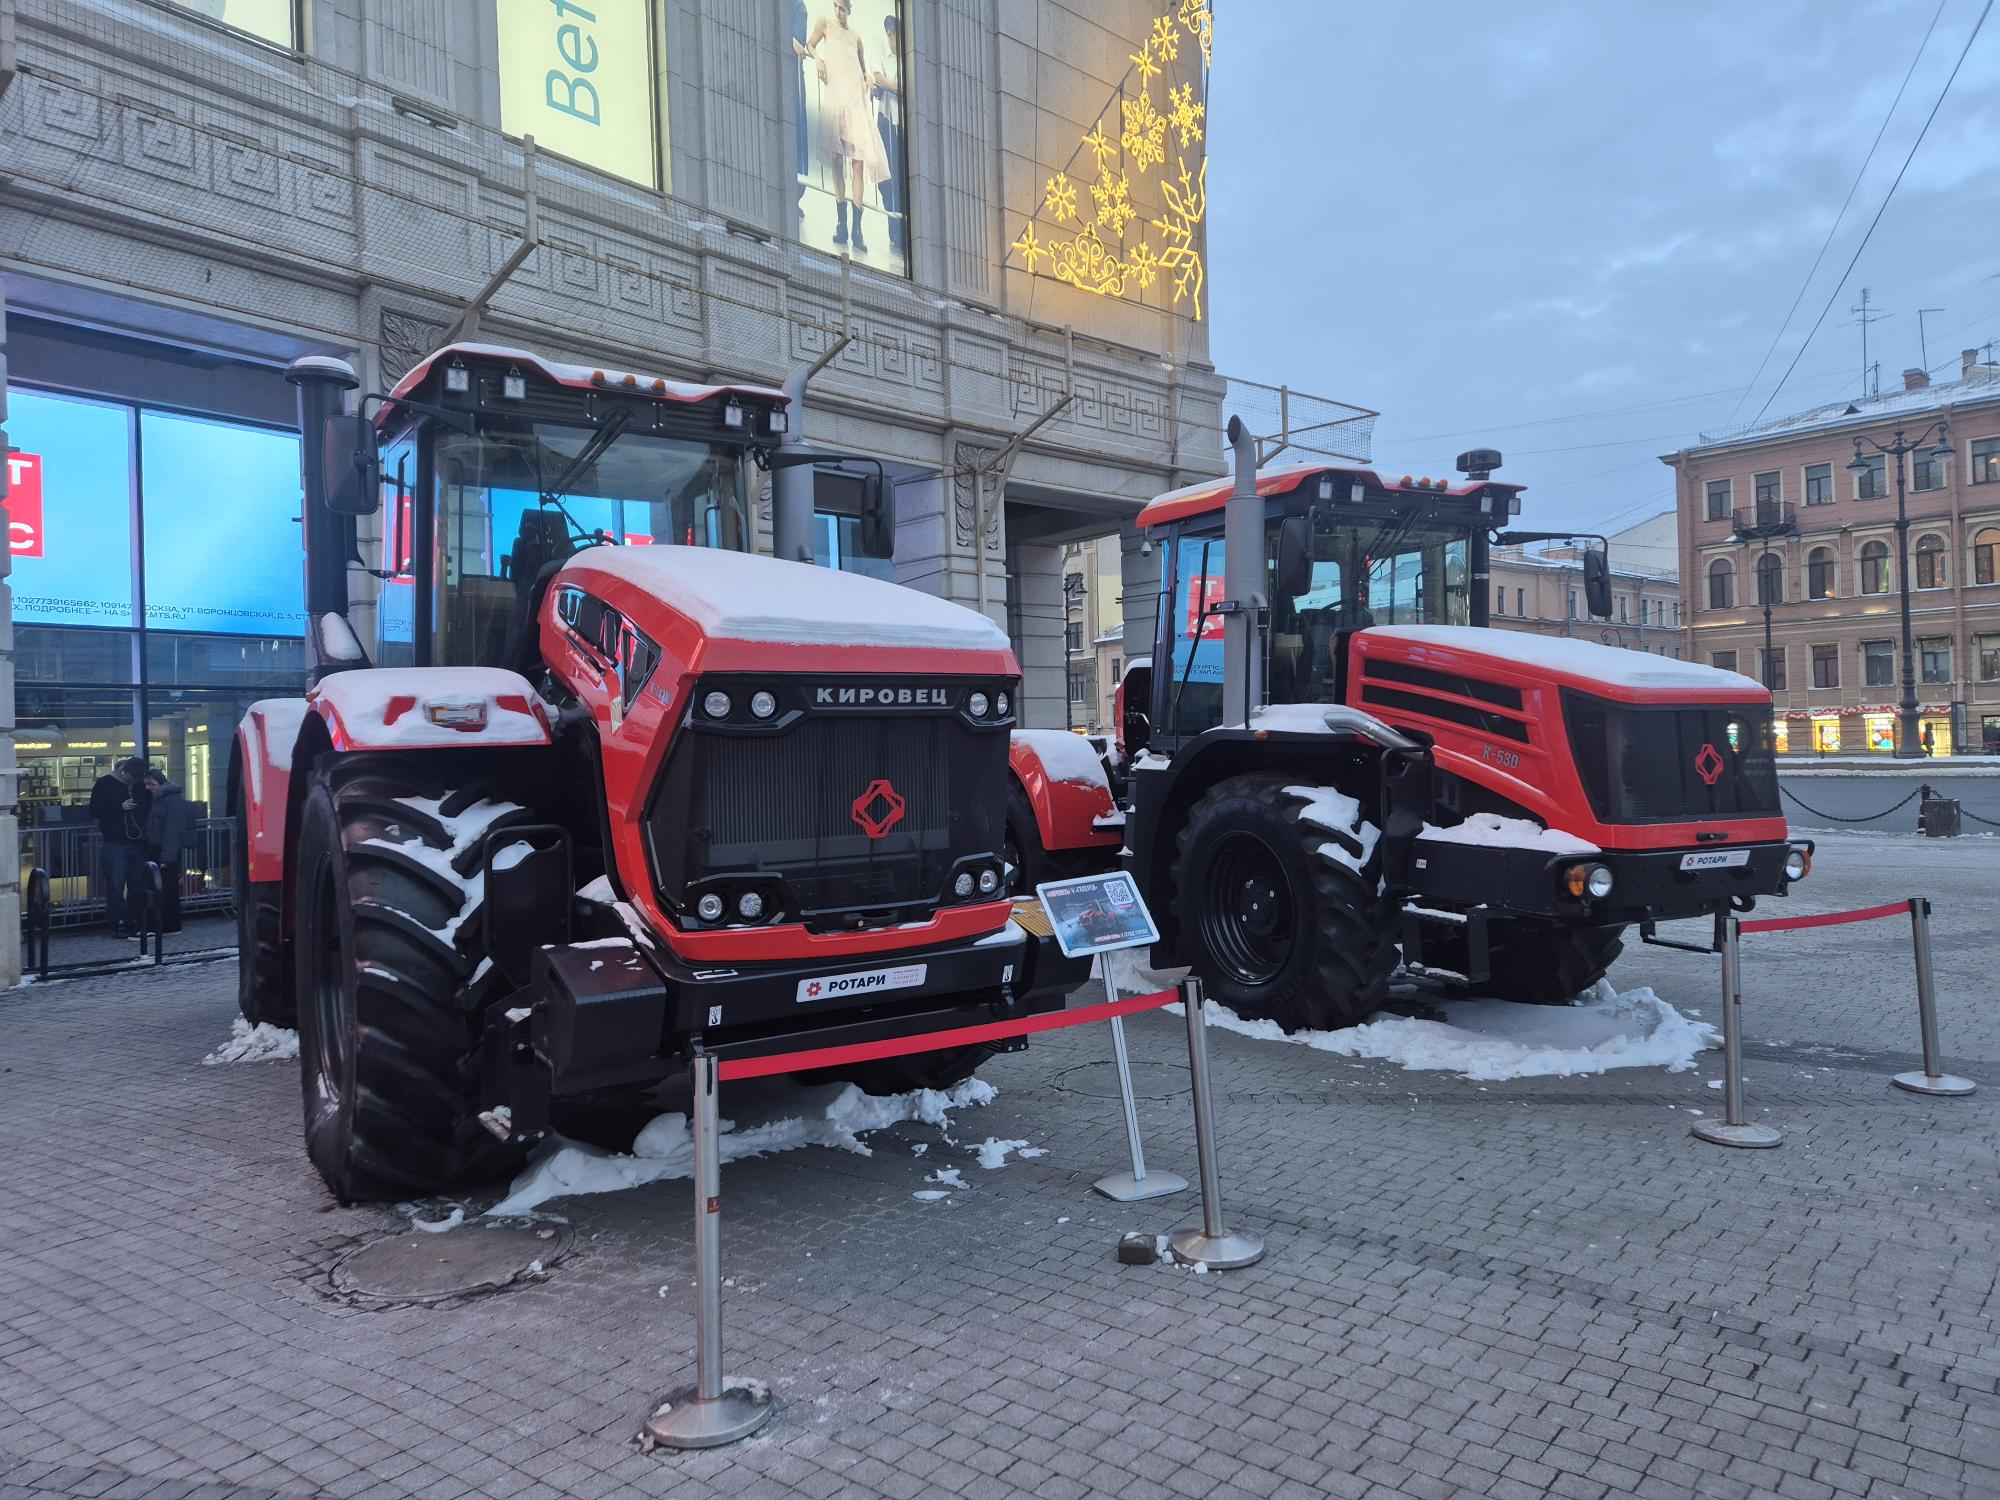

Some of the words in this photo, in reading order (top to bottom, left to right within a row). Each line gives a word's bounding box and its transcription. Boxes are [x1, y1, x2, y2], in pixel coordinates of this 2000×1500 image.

[25, 604, 92, 614] ПОДРОБНЕЕ
[816, 687, 947, 705] КИРОВЕЦ
[1696, 855, 1728, 865] РОТАРИ
[828, 974, 887, 993] РОТАРИ
